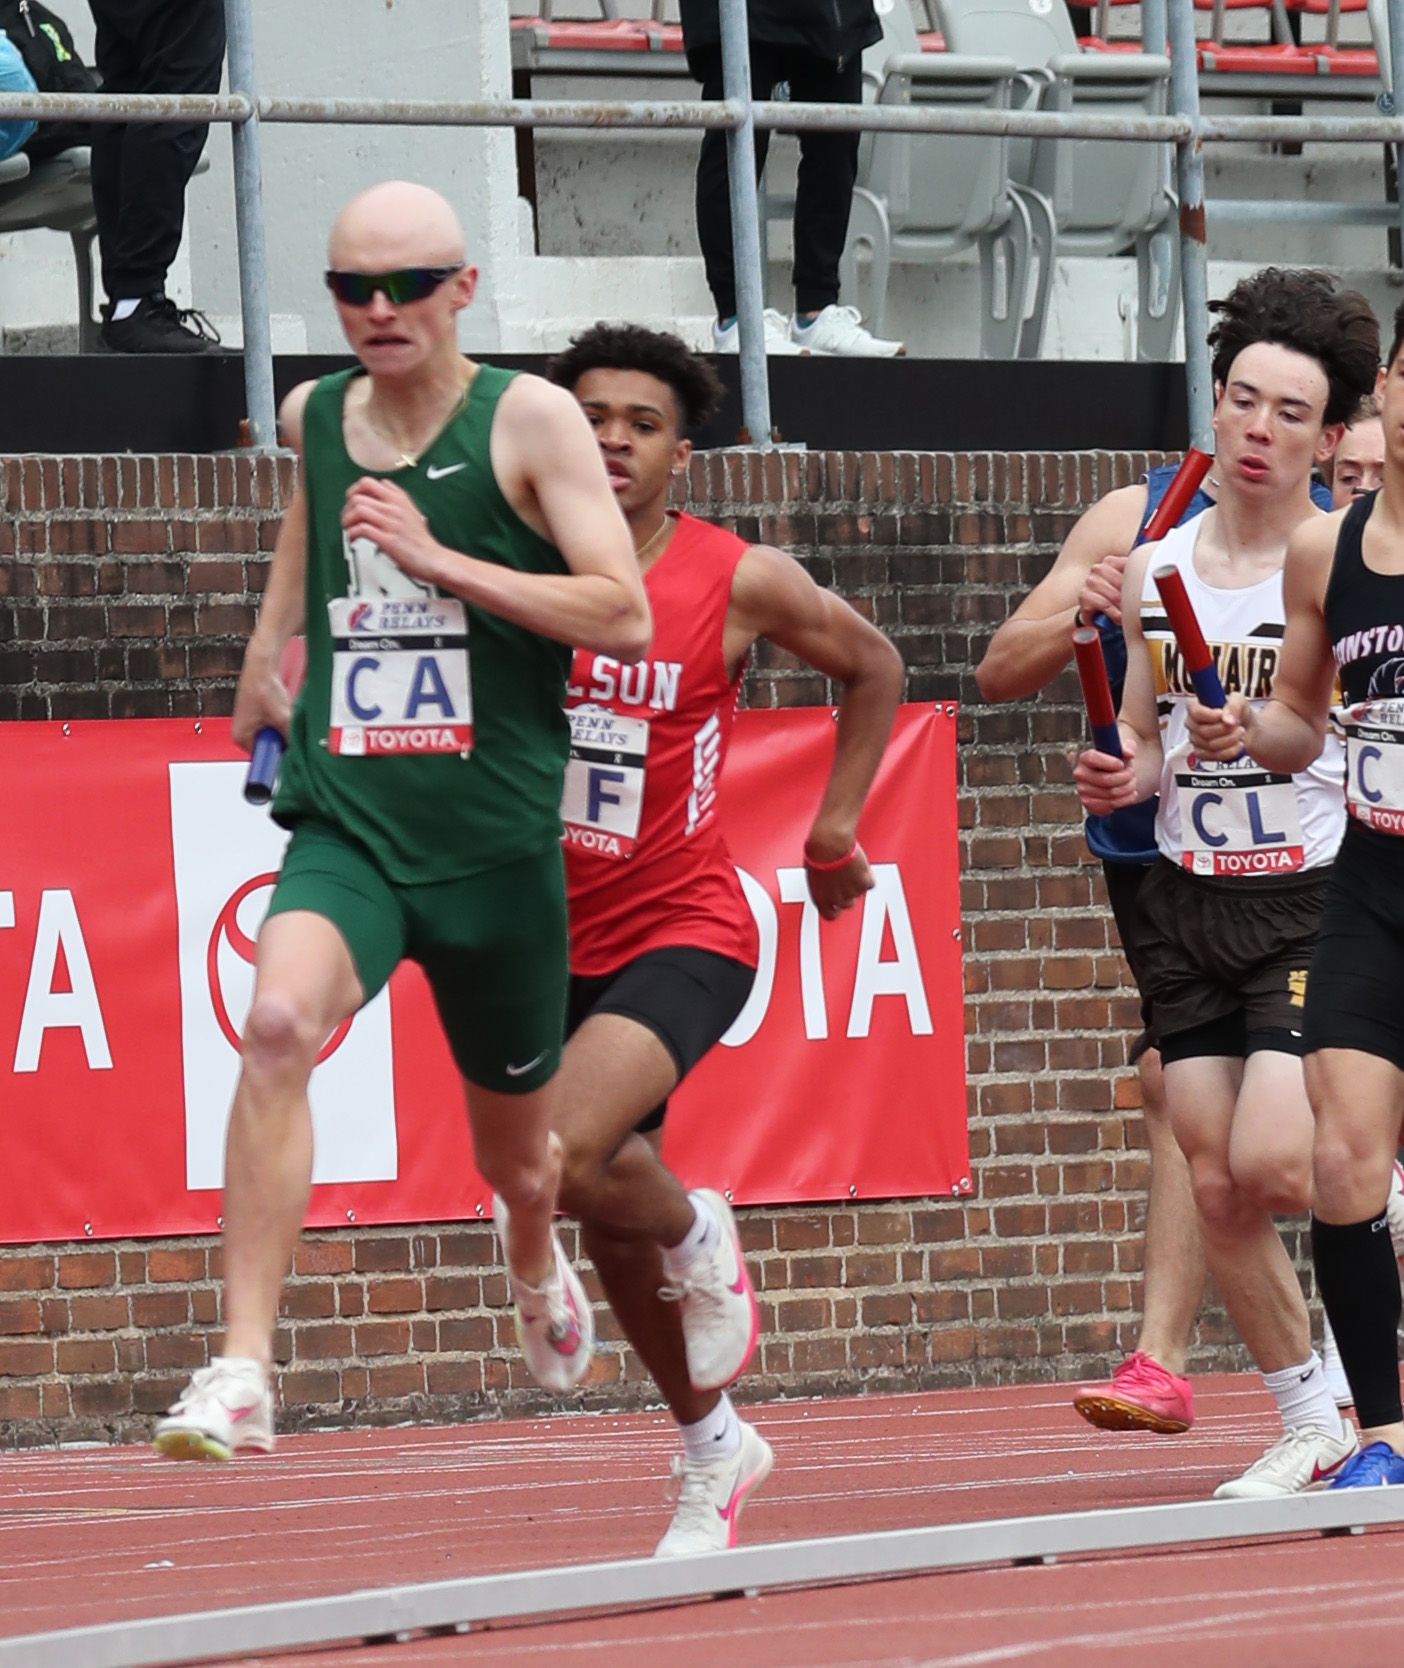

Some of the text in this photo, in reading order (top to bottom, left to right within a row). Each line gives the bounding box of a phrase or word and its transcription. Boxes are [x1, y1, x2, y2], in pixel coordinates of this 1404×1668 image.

[381, 602, 428, 614] PENN
[379, 615, 446, 628] RELAYS
[1162, 640, 1280, 699] MAIR
[366, 728, 460, 749] TOYOTA
[571, 728, 629, 746] ELAYS
[1216, 758, 1262, 770] RELA
[1191, 776, 1218, 787] Dream
[586, 767, 625, 823] F
[1216, 850, 1294, 871] TOYOTA
